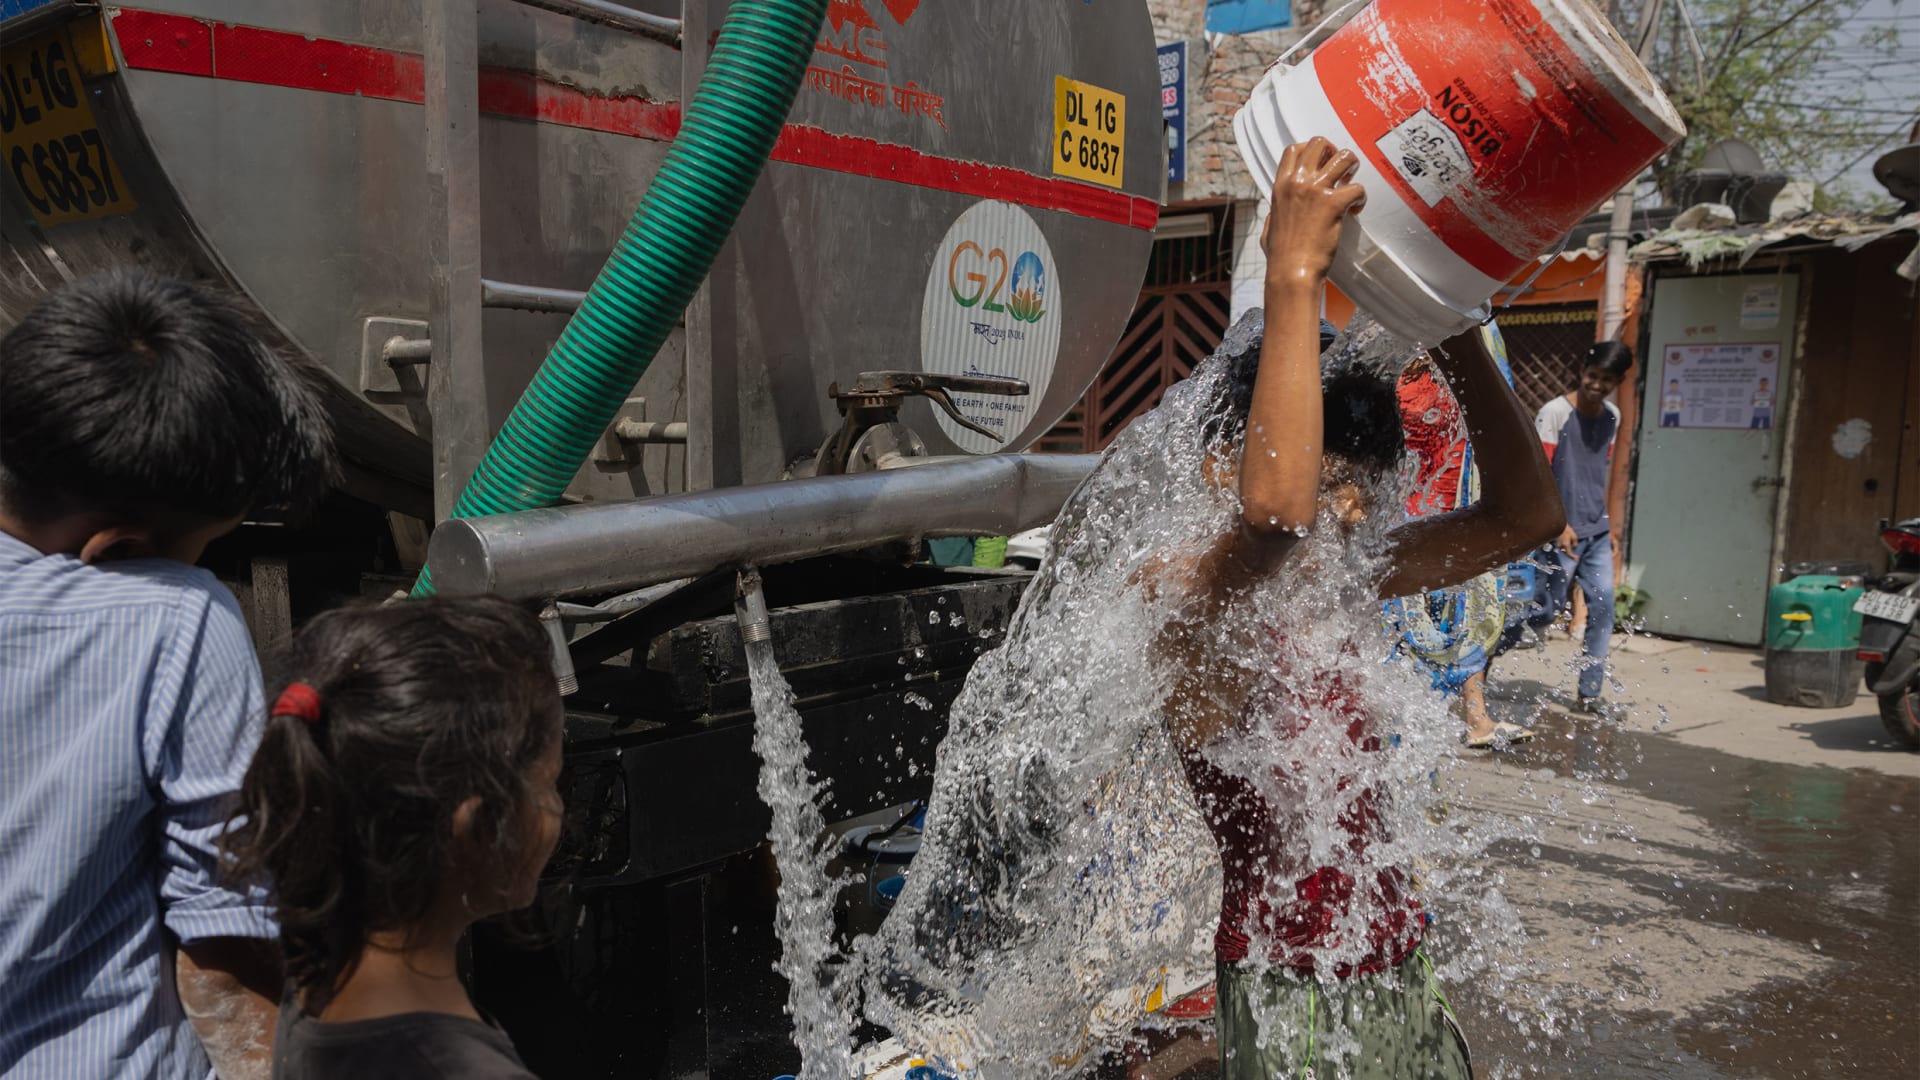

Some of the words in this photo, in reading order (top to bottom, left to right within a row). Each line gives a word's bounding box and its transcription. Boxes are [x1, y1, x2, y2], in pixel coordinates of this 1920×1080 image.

[1066, 90, 1088, 127] DL
[1095, 99, 1116, 134] 1G
[1435, 85, 1500, 158] BISON
[11, 128, 120, 214] C6837
[1061, 130, 1072, 163] C
[1079, 135, 1120, 176] 6837
[1405, 125, 1463, 184] Berger
[949, 240, 1046, 323] G20
[962, 398, 984, 409] EARTH
[990, 401, 1004, 410] ONE
[1004, 403, 1025, 413] FAMILY
[981, 416, 1004, 426] FUTURE
